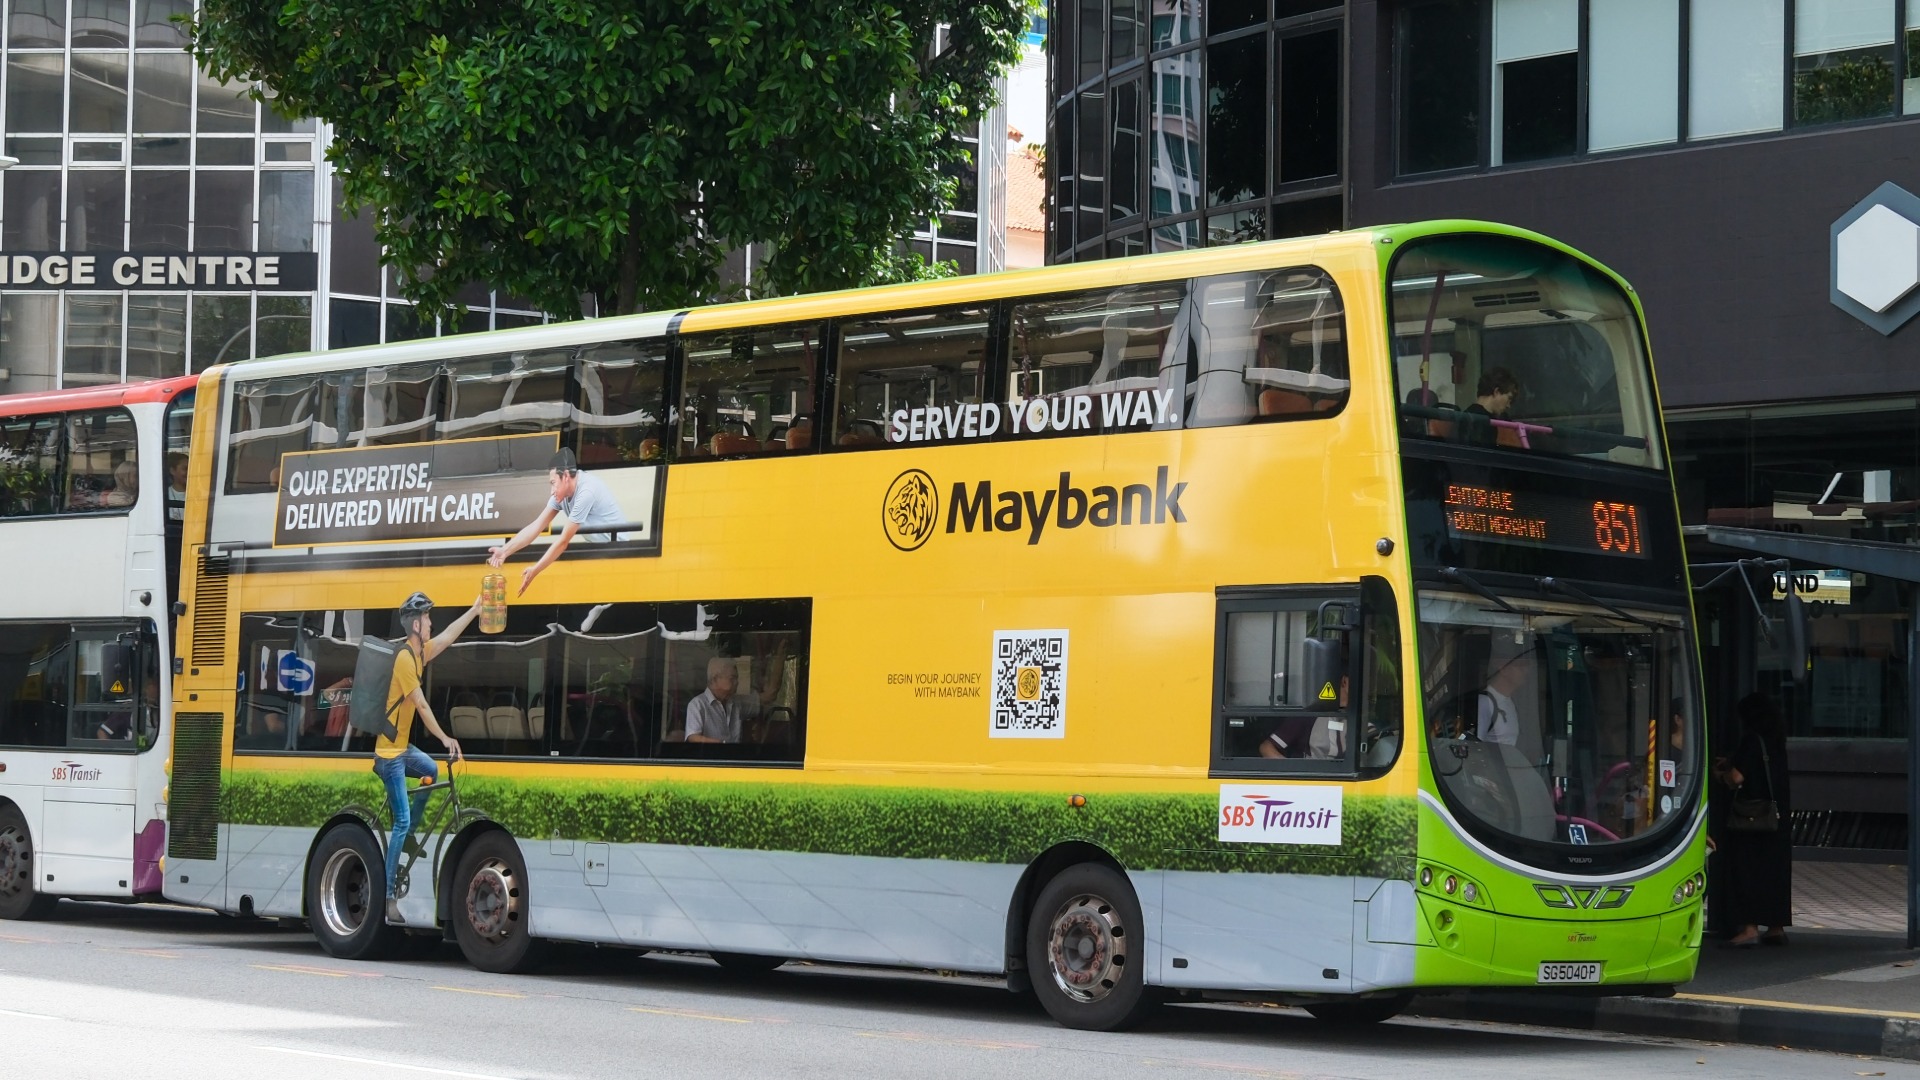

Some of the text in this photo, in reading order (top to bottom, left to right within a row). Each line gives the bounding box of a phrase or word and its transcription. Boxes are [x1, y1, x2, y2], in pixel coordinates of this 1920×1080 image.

[0, 255, 279, 285] IDGE CENTRE
[891, 388, 1178, 443] SERVED YOUR WAY.
[289, 462, 433, 497] OUR EXPERTISE,
[285, 492, 500, 531] DELIVERED WITH CARE.
[946, 465, 1189, 546] Maybank
[1592, 501, 1641, 554] 851
[1772, 574, 1819, 594] UND
[887, 672, 982, 684] BEGIN YOUR JOURNEY
[914, 686, 981, 698] WITH MAYBANK
[52, 763, 103, 783] SBS Transit
[1221, 800, 1338, 832] SBS Transit
[1543, 965, 1596, 980] SG5040P
